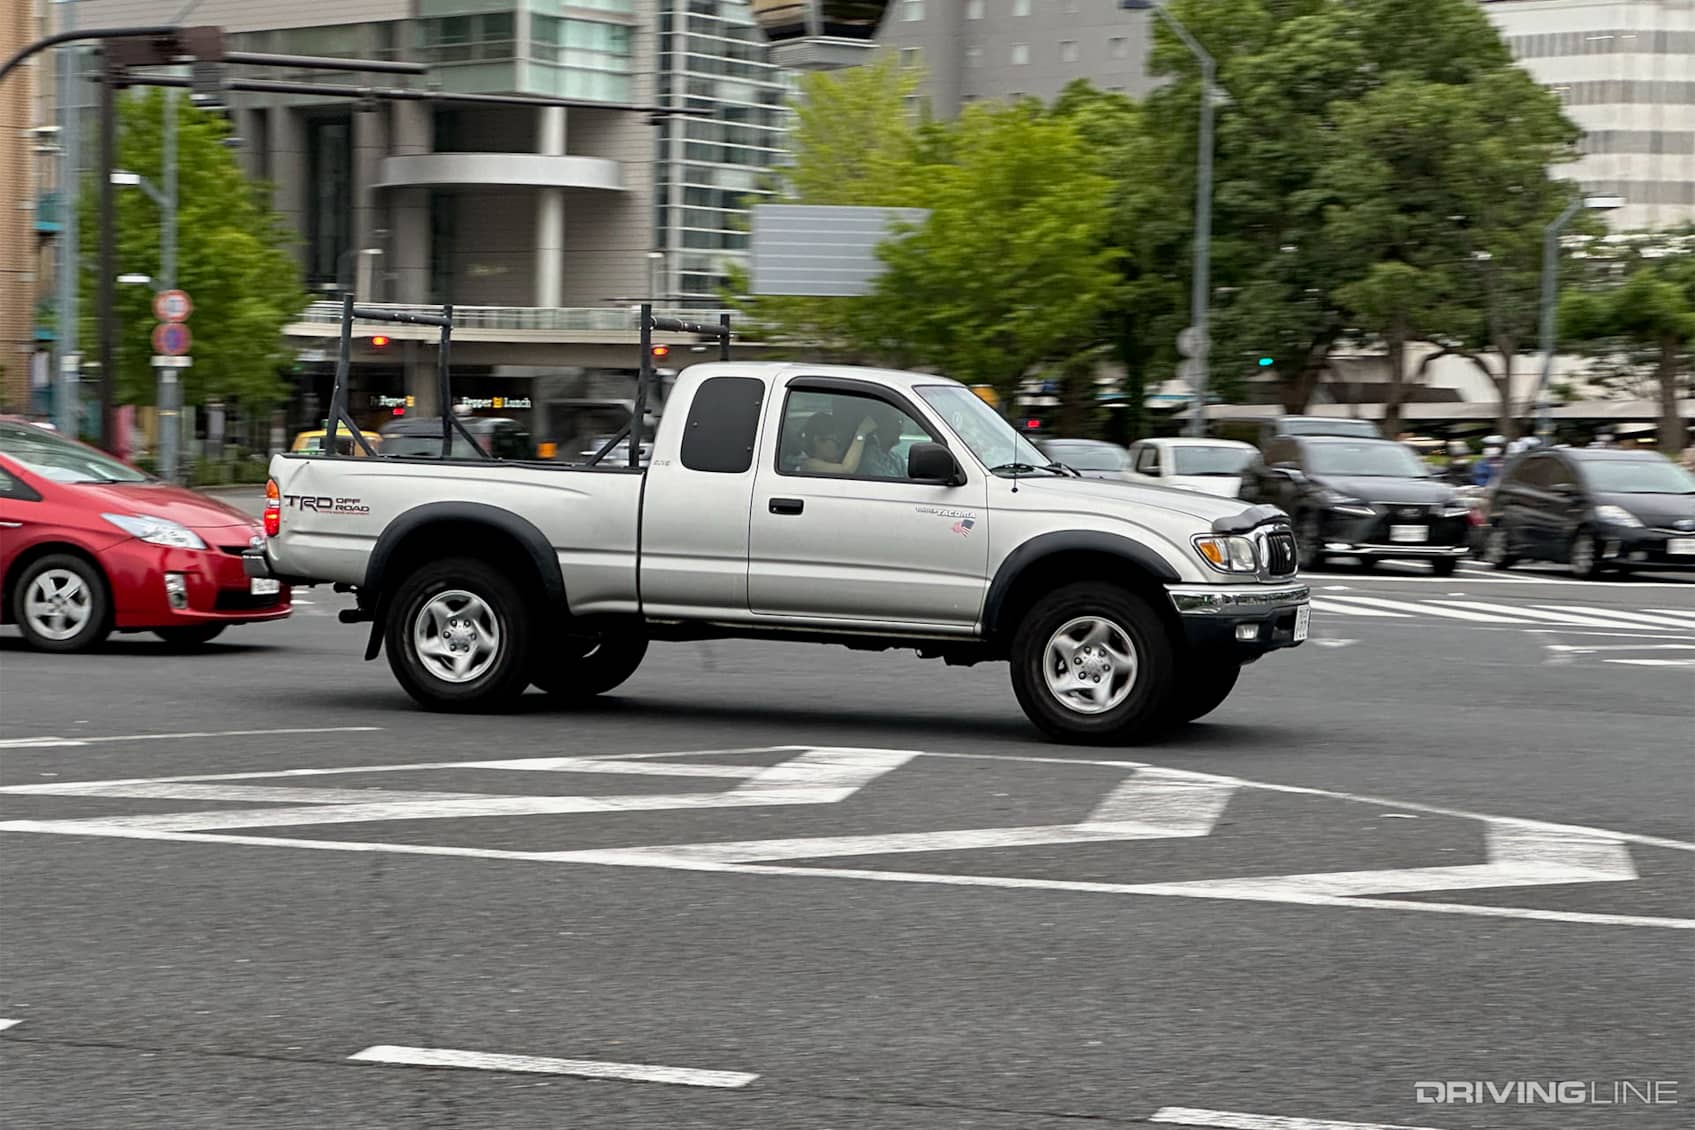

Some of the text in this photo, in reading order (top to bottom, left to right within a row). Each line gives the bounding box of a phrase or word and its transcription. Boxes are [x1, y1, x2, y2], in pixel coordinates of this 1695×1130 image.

[462, 396, 532, 409] Pepper Lunch
[283, 495, 333, 512] TRD
[335, 504, 370, 512] ROAD
[936, 510, 976, 519] TACOMA
